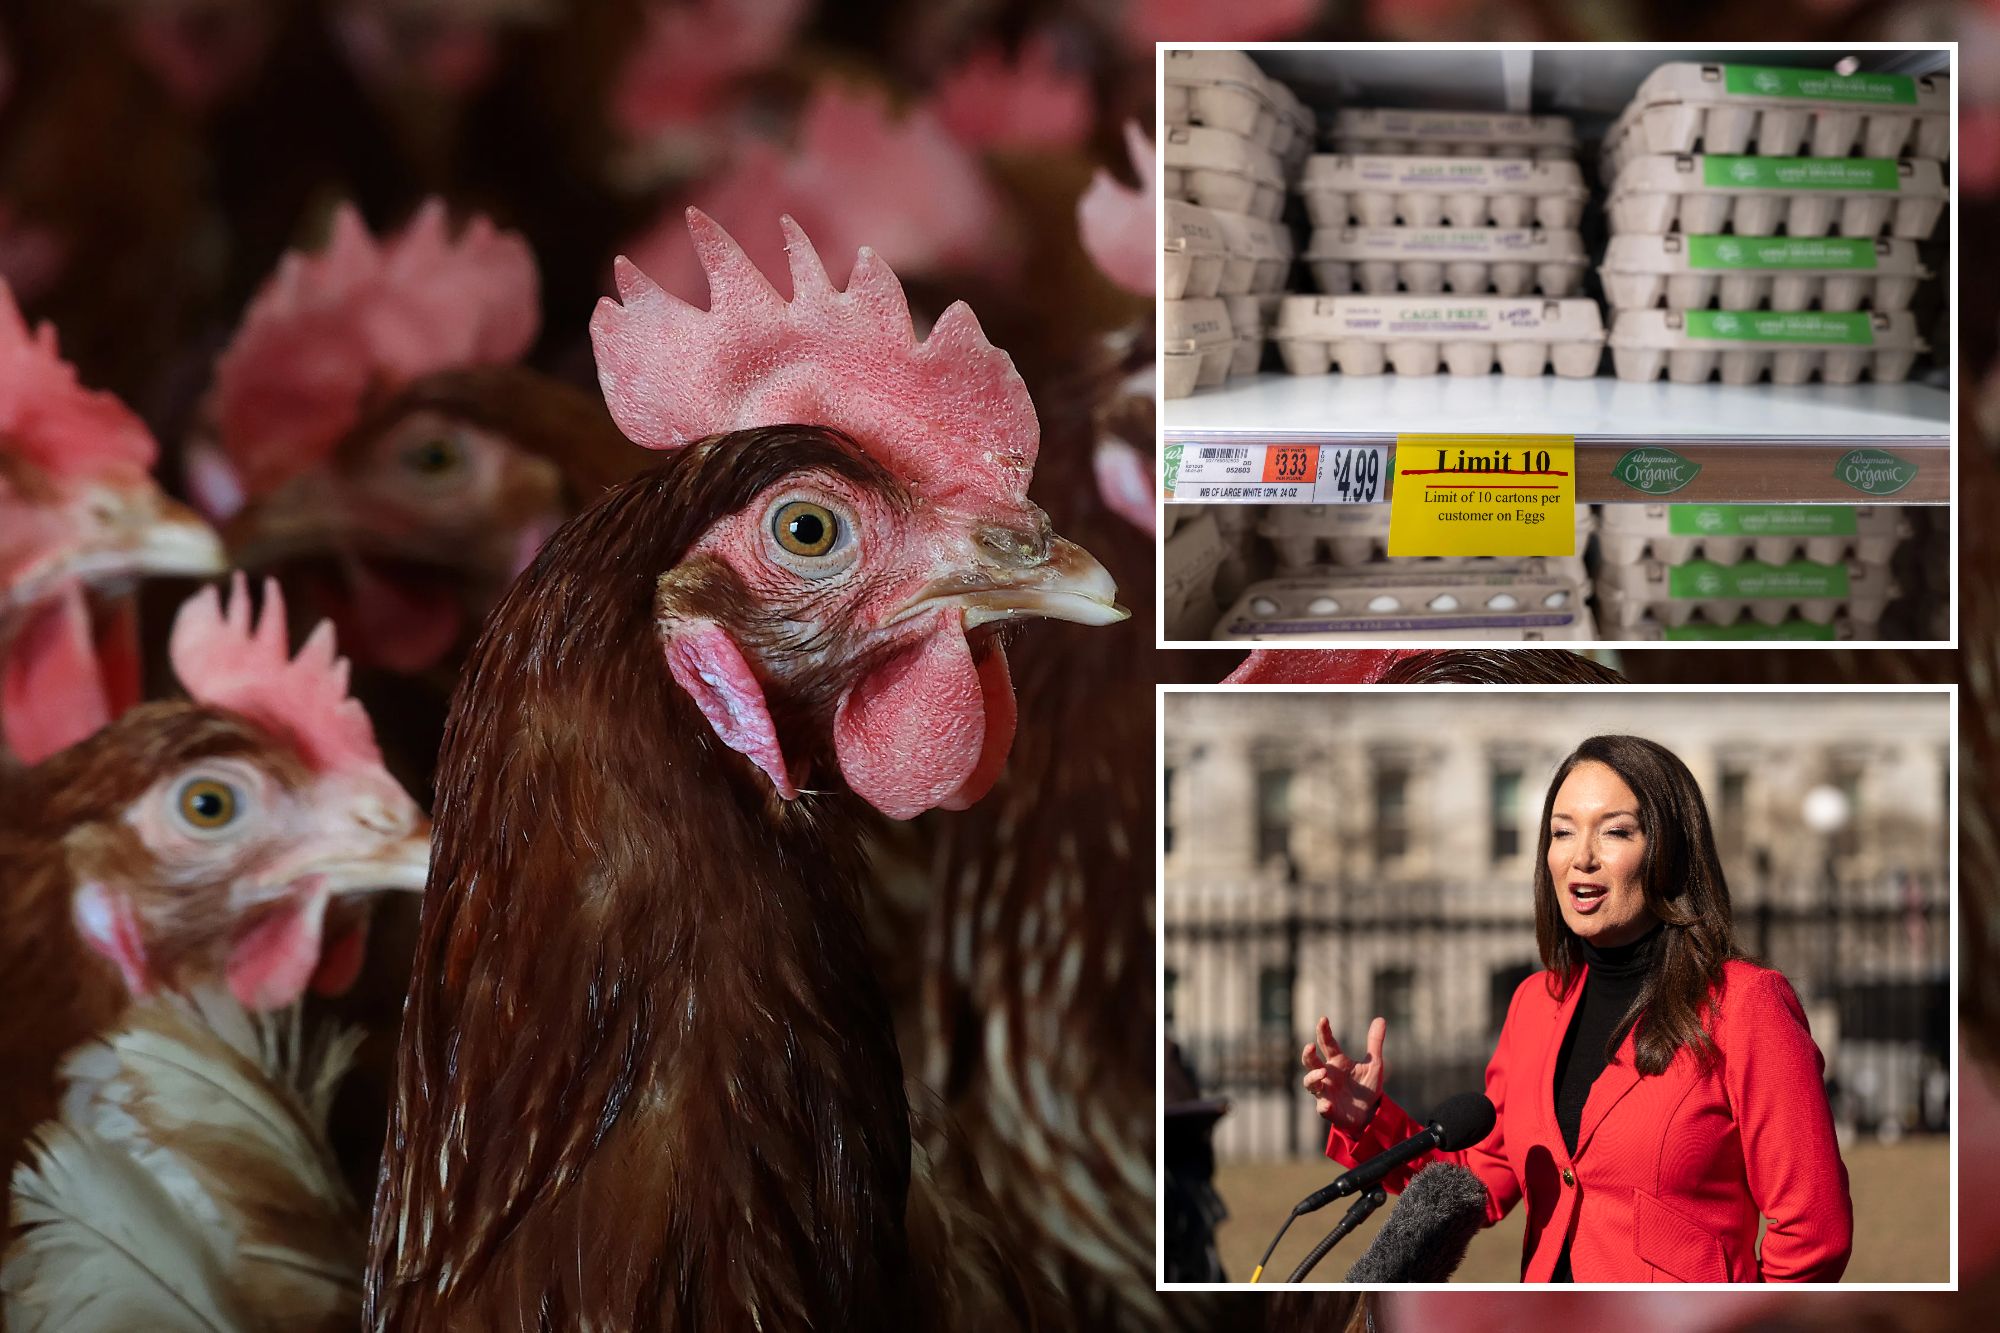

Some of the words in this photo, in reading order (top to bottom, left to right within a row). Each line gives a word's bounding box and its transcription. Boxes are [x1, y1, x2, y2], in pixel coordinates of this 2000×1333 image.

[1400, 308, 1441, 320] CAGE
[1447, 308, 1488, 320] FREE
[1276, 453, 1307, 476] $3.33
[1437, 450, 1512, 473] Limit
[1522, 450, 1550, 473] 10
[1632, 451, 1676, 468] Wegmans
[1850, 452, 1894, 469] Wegmans
[1334, 449, 1379, 502] $4.99
[1200, 488, 1210, 497] WB
[1212, 488, 1220, 497] CF
[1220, 488, 1241, 497] LARGE
[1242, 488, 1262, 497] WHITE
[1263, 488, 1278, 497] 12PK
[1280, 488, 1288, 497] 24
[1288, 488, 1298, 497] OZ
[1424, 491, 1458, 502] Limit
[1461, 491, 1476, 502] of
[1478, 492, 1492, 502] 10
[1496, 493, 1538, 503] cartons
[1542, 495, 1560, 506] per
[1438, 510, 1494, 521] customer
[1496, 513, 1512, 521] on
[1516, 510, 1545, 524] Eggs
